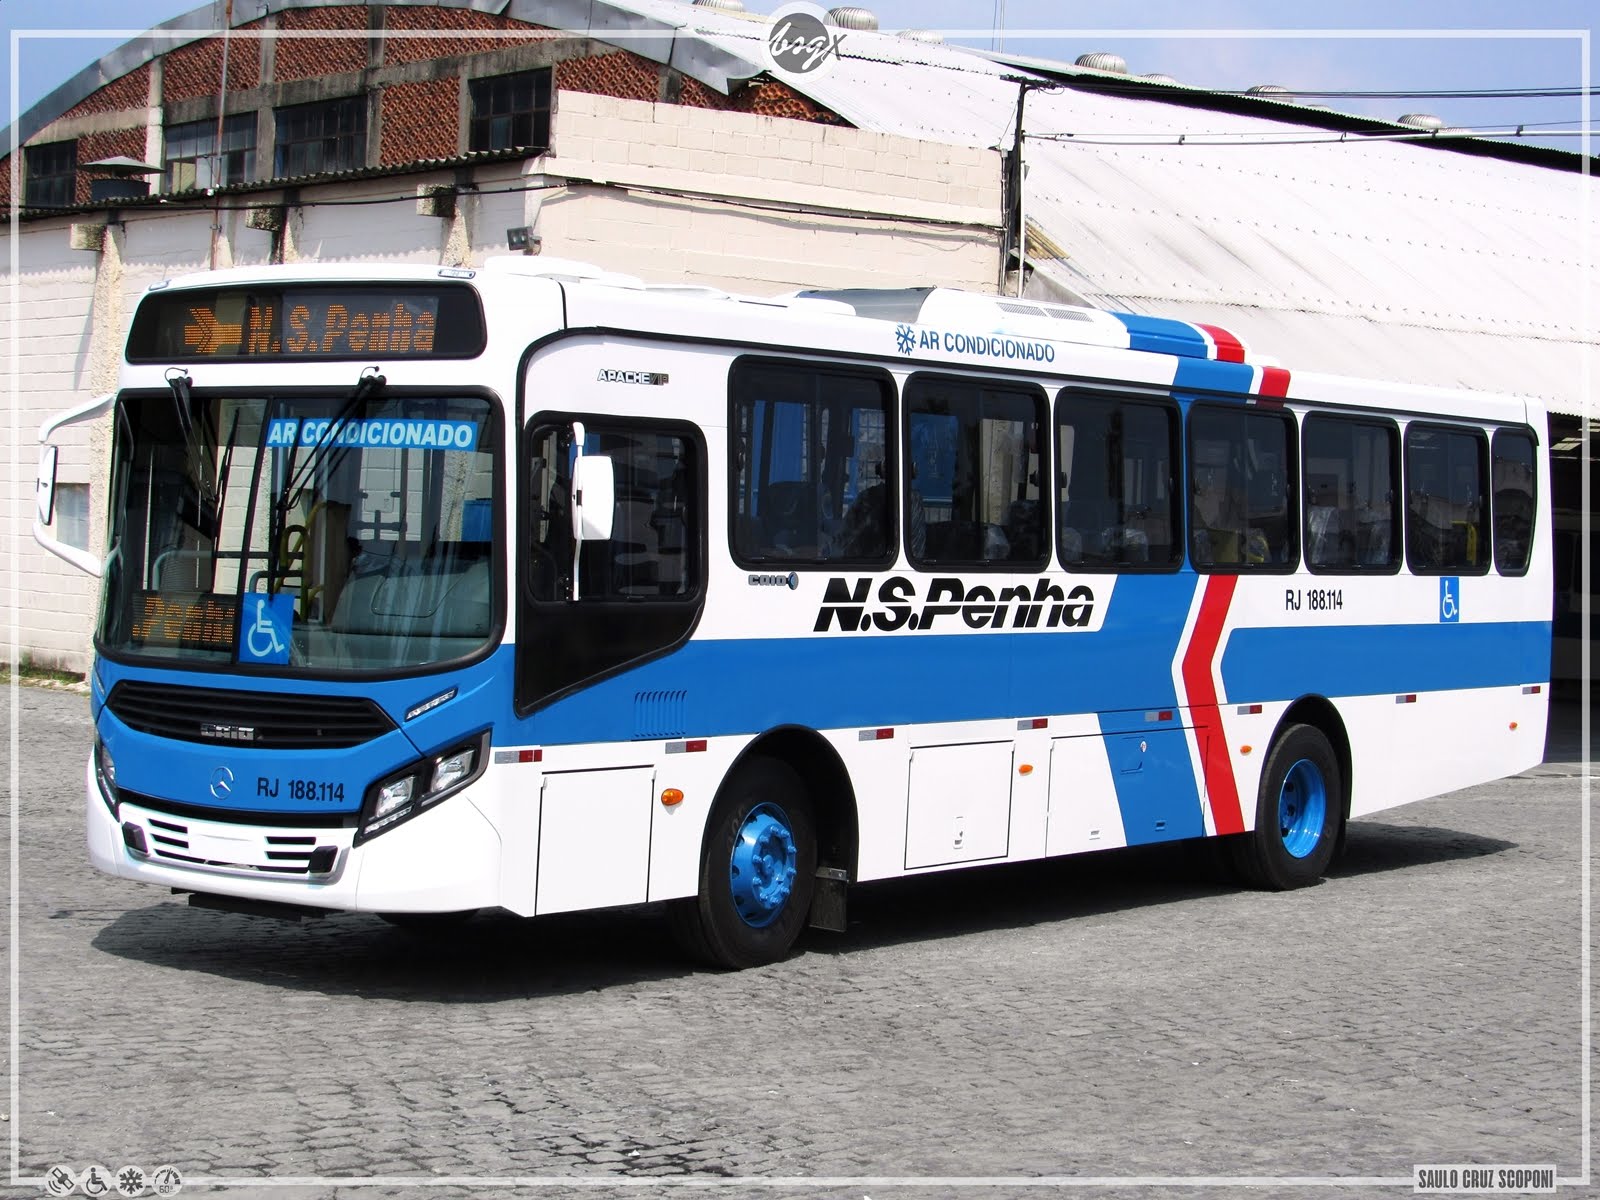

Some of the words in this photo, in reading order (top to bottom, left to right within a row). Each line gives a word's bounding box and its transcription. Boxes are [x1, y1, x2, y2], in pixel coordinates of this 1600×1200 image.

[920, 330, 940, 350] AR
[944, 332, 1055, 363] CONDICIONADO
[268, 422, 297, 444] AR
[302, 422, 473, 448] CONDICIONADO
[1286, 589, 1301, 610] RJ
[1306, 589, 1343, 610] 188.114
[257, 777, 279, 797] RJ
[288, 779, 344, 802] 188.114
